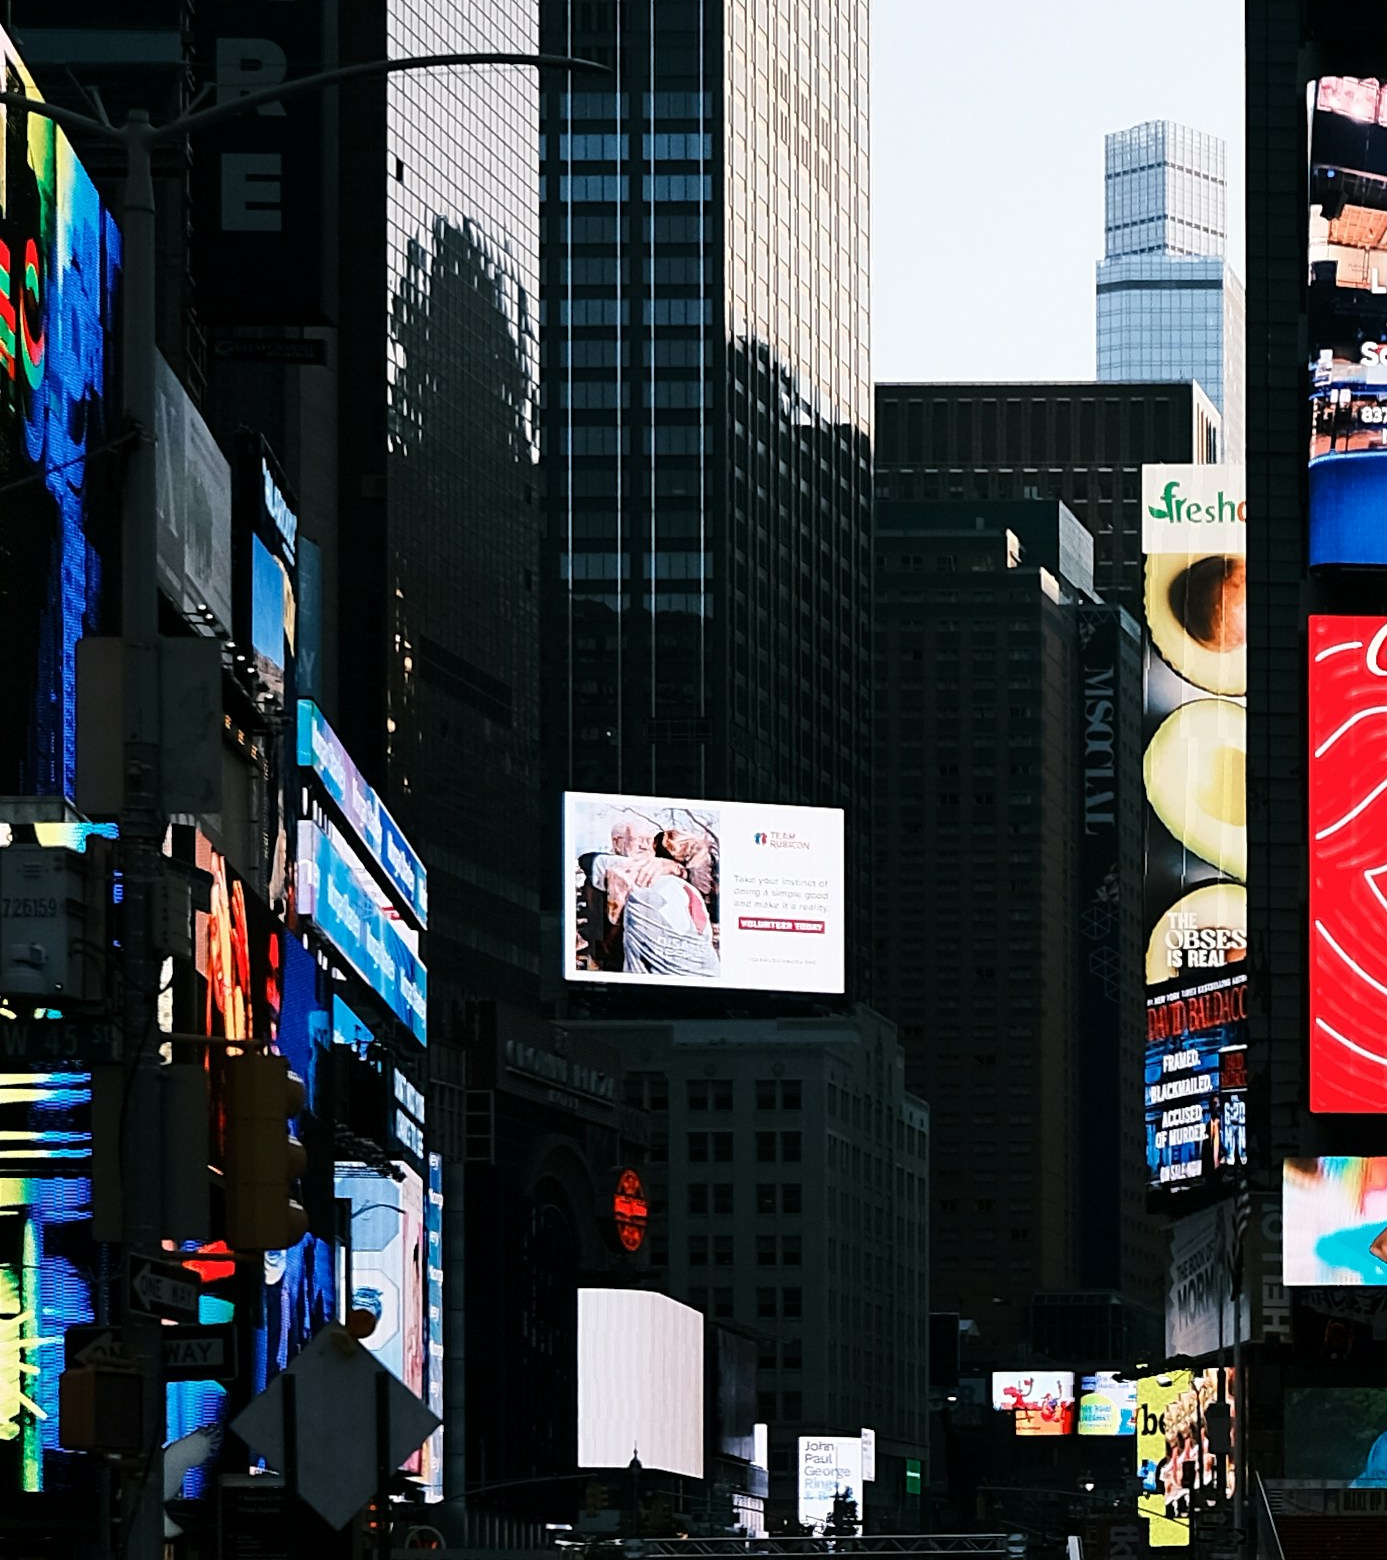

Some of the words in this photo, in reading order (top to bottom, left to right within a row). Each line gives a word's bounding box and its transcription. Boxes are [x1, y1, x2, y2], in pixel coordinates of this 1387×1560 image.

[769, 831, 796, 840] TEAM
[769, 840, 811, 851] RUBICON
[734, 875, 755, 885] Take
[758, 877, 780, 889] your
[818, 879, 829, 888] of
[733, 886, 760, 898] doing
[771, 889, 802, 901] simple
[805, 891, 829, 902] good
[2, 898, 58, 918] 726159
[733, 898, 752, 908] and
[754, 900, 780, 910] make
[740, 920, 793, 930] VOLUNTEER
[795, 922, 823, 932] TODAY
[1166, 911, 1198, 930] THE
[1166, 949, 1183, 968] IS
[1147, 1000, 1187, 1041] DAVID
[1188, 984, 1248, 1033] BALDACC
[44, 1026, 78, 1055] 45
[1162, 1049, 1202, 1074] FRAMED.
[1150, 1074, 1213, 1104] BLACKMAILED.
[1161, 1104, 1203, 1129] ACCUSED
[1155, 1130, 1168, 1150] OF
[1168, 1123, 1210, 1147] MURDER.
[140, 1274, 167, 1298] ONE
[170, 1280, 197, 1306] WAY
[805, 1441, 835, 1451] John
[804, 1453, 832, 1464] Paul
[804, 1466, 851, 1479] George
